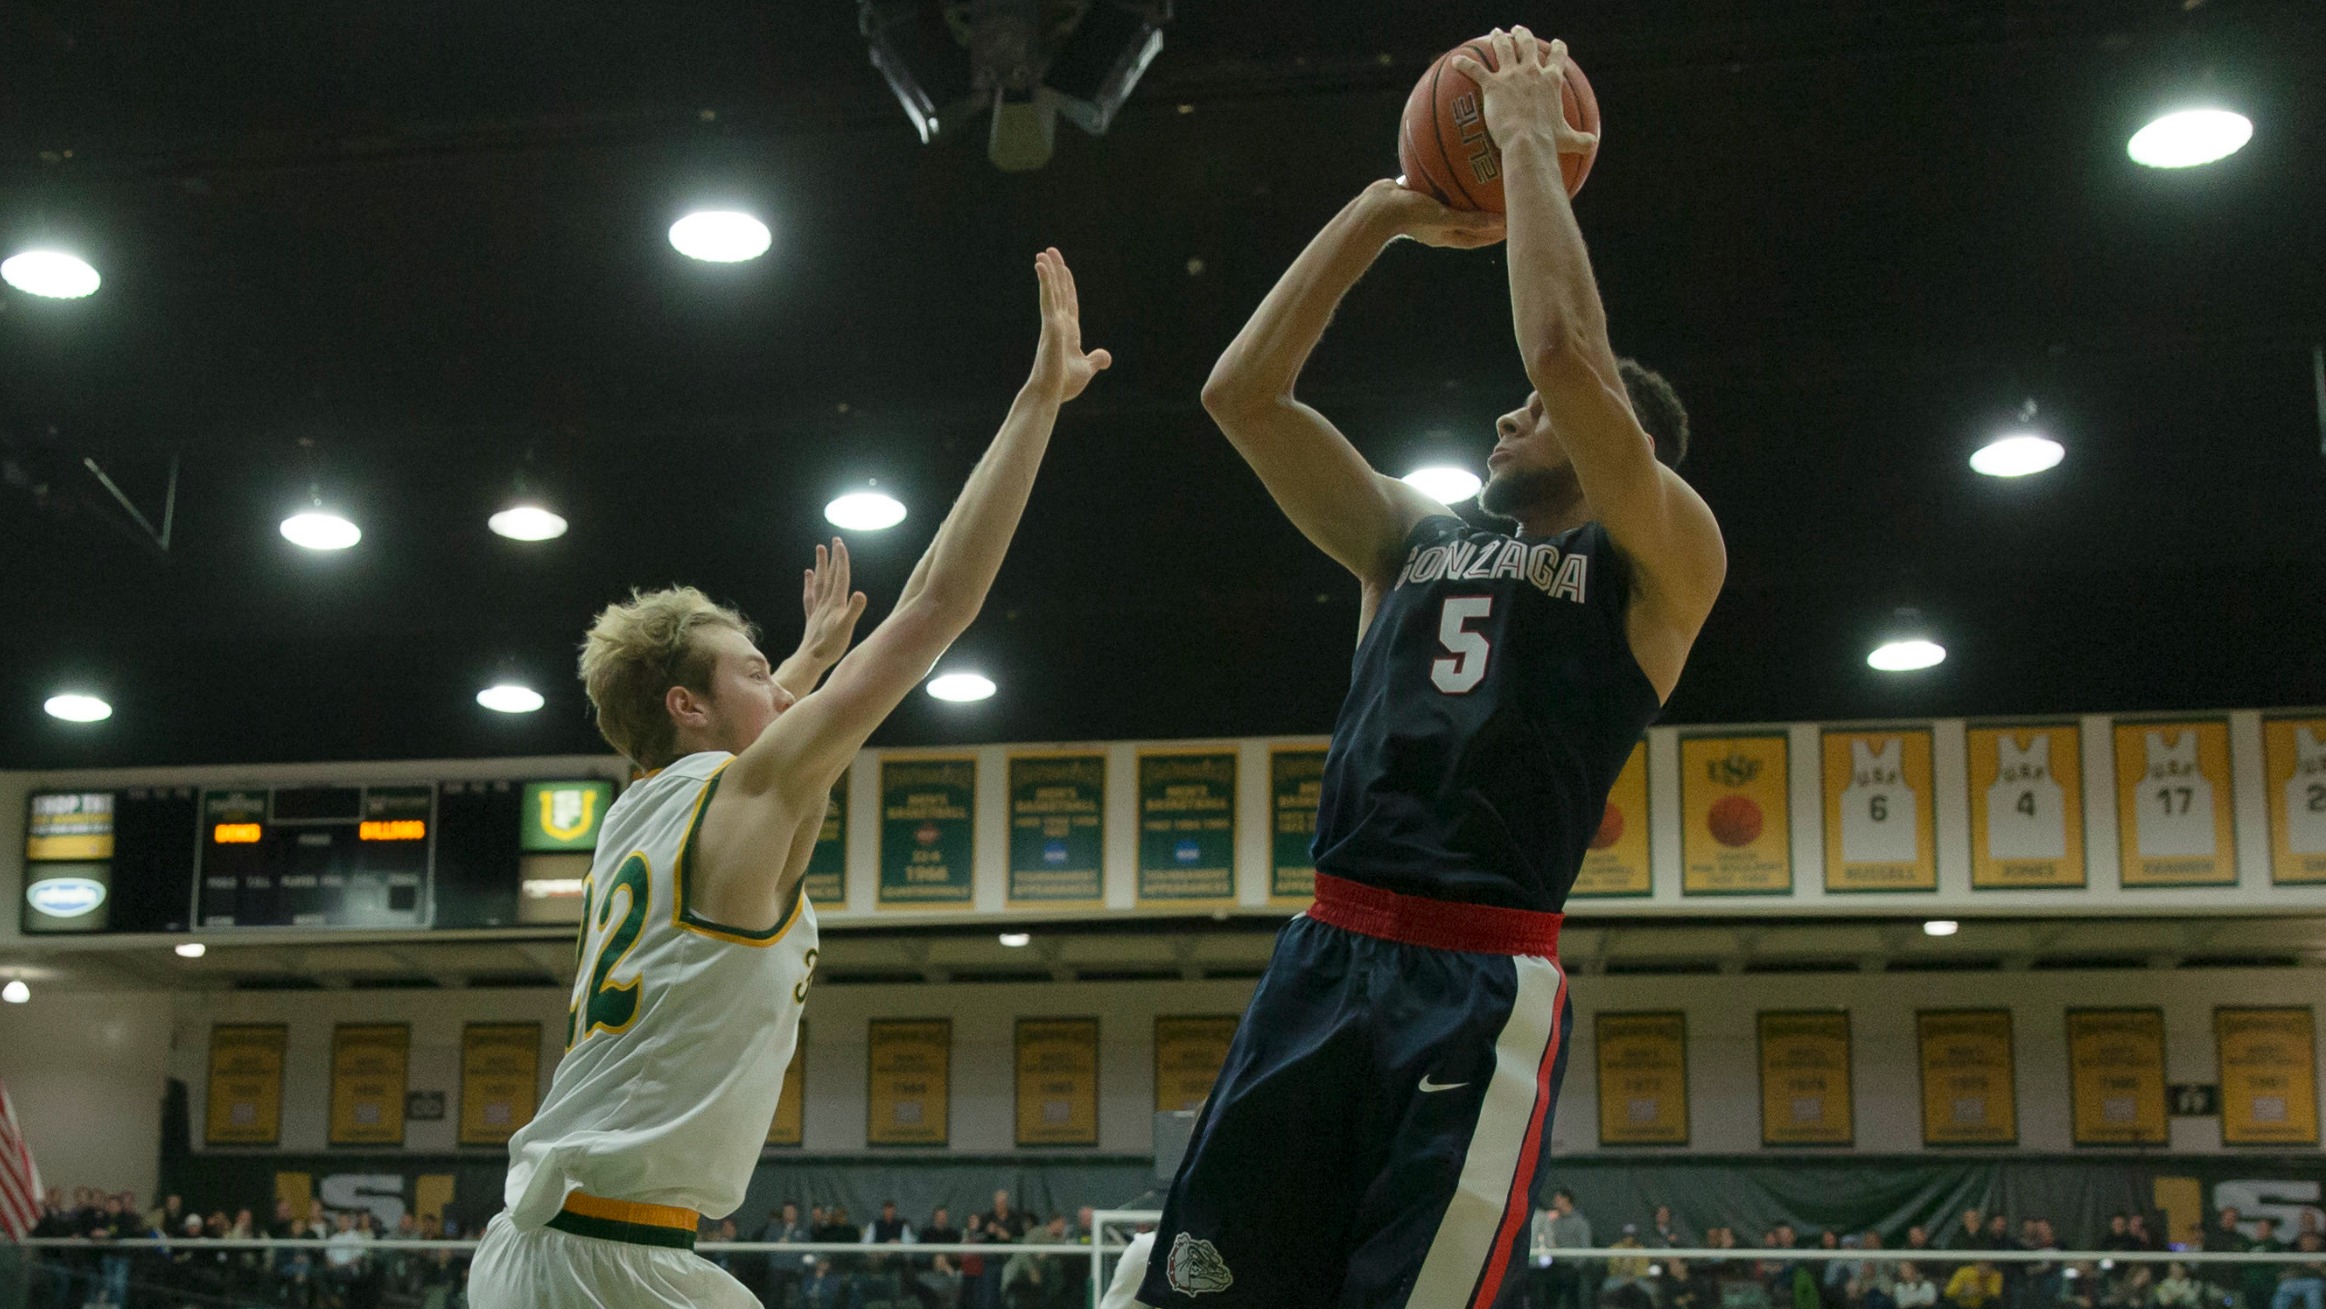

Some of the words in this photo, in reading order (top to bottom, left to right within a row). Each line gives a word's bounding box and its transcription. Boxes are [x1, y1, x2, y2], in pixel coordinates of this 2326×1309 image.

[1452, 92, 1499, 184] ELITE
[1431, 595, 1493, 694] 5
[1869, 795, 1889, 822] 6
[2015, 789, 2036, 817] 4
[2157, 786, 2193, 815] 17
[2305, 784, 2326, 812] 2
